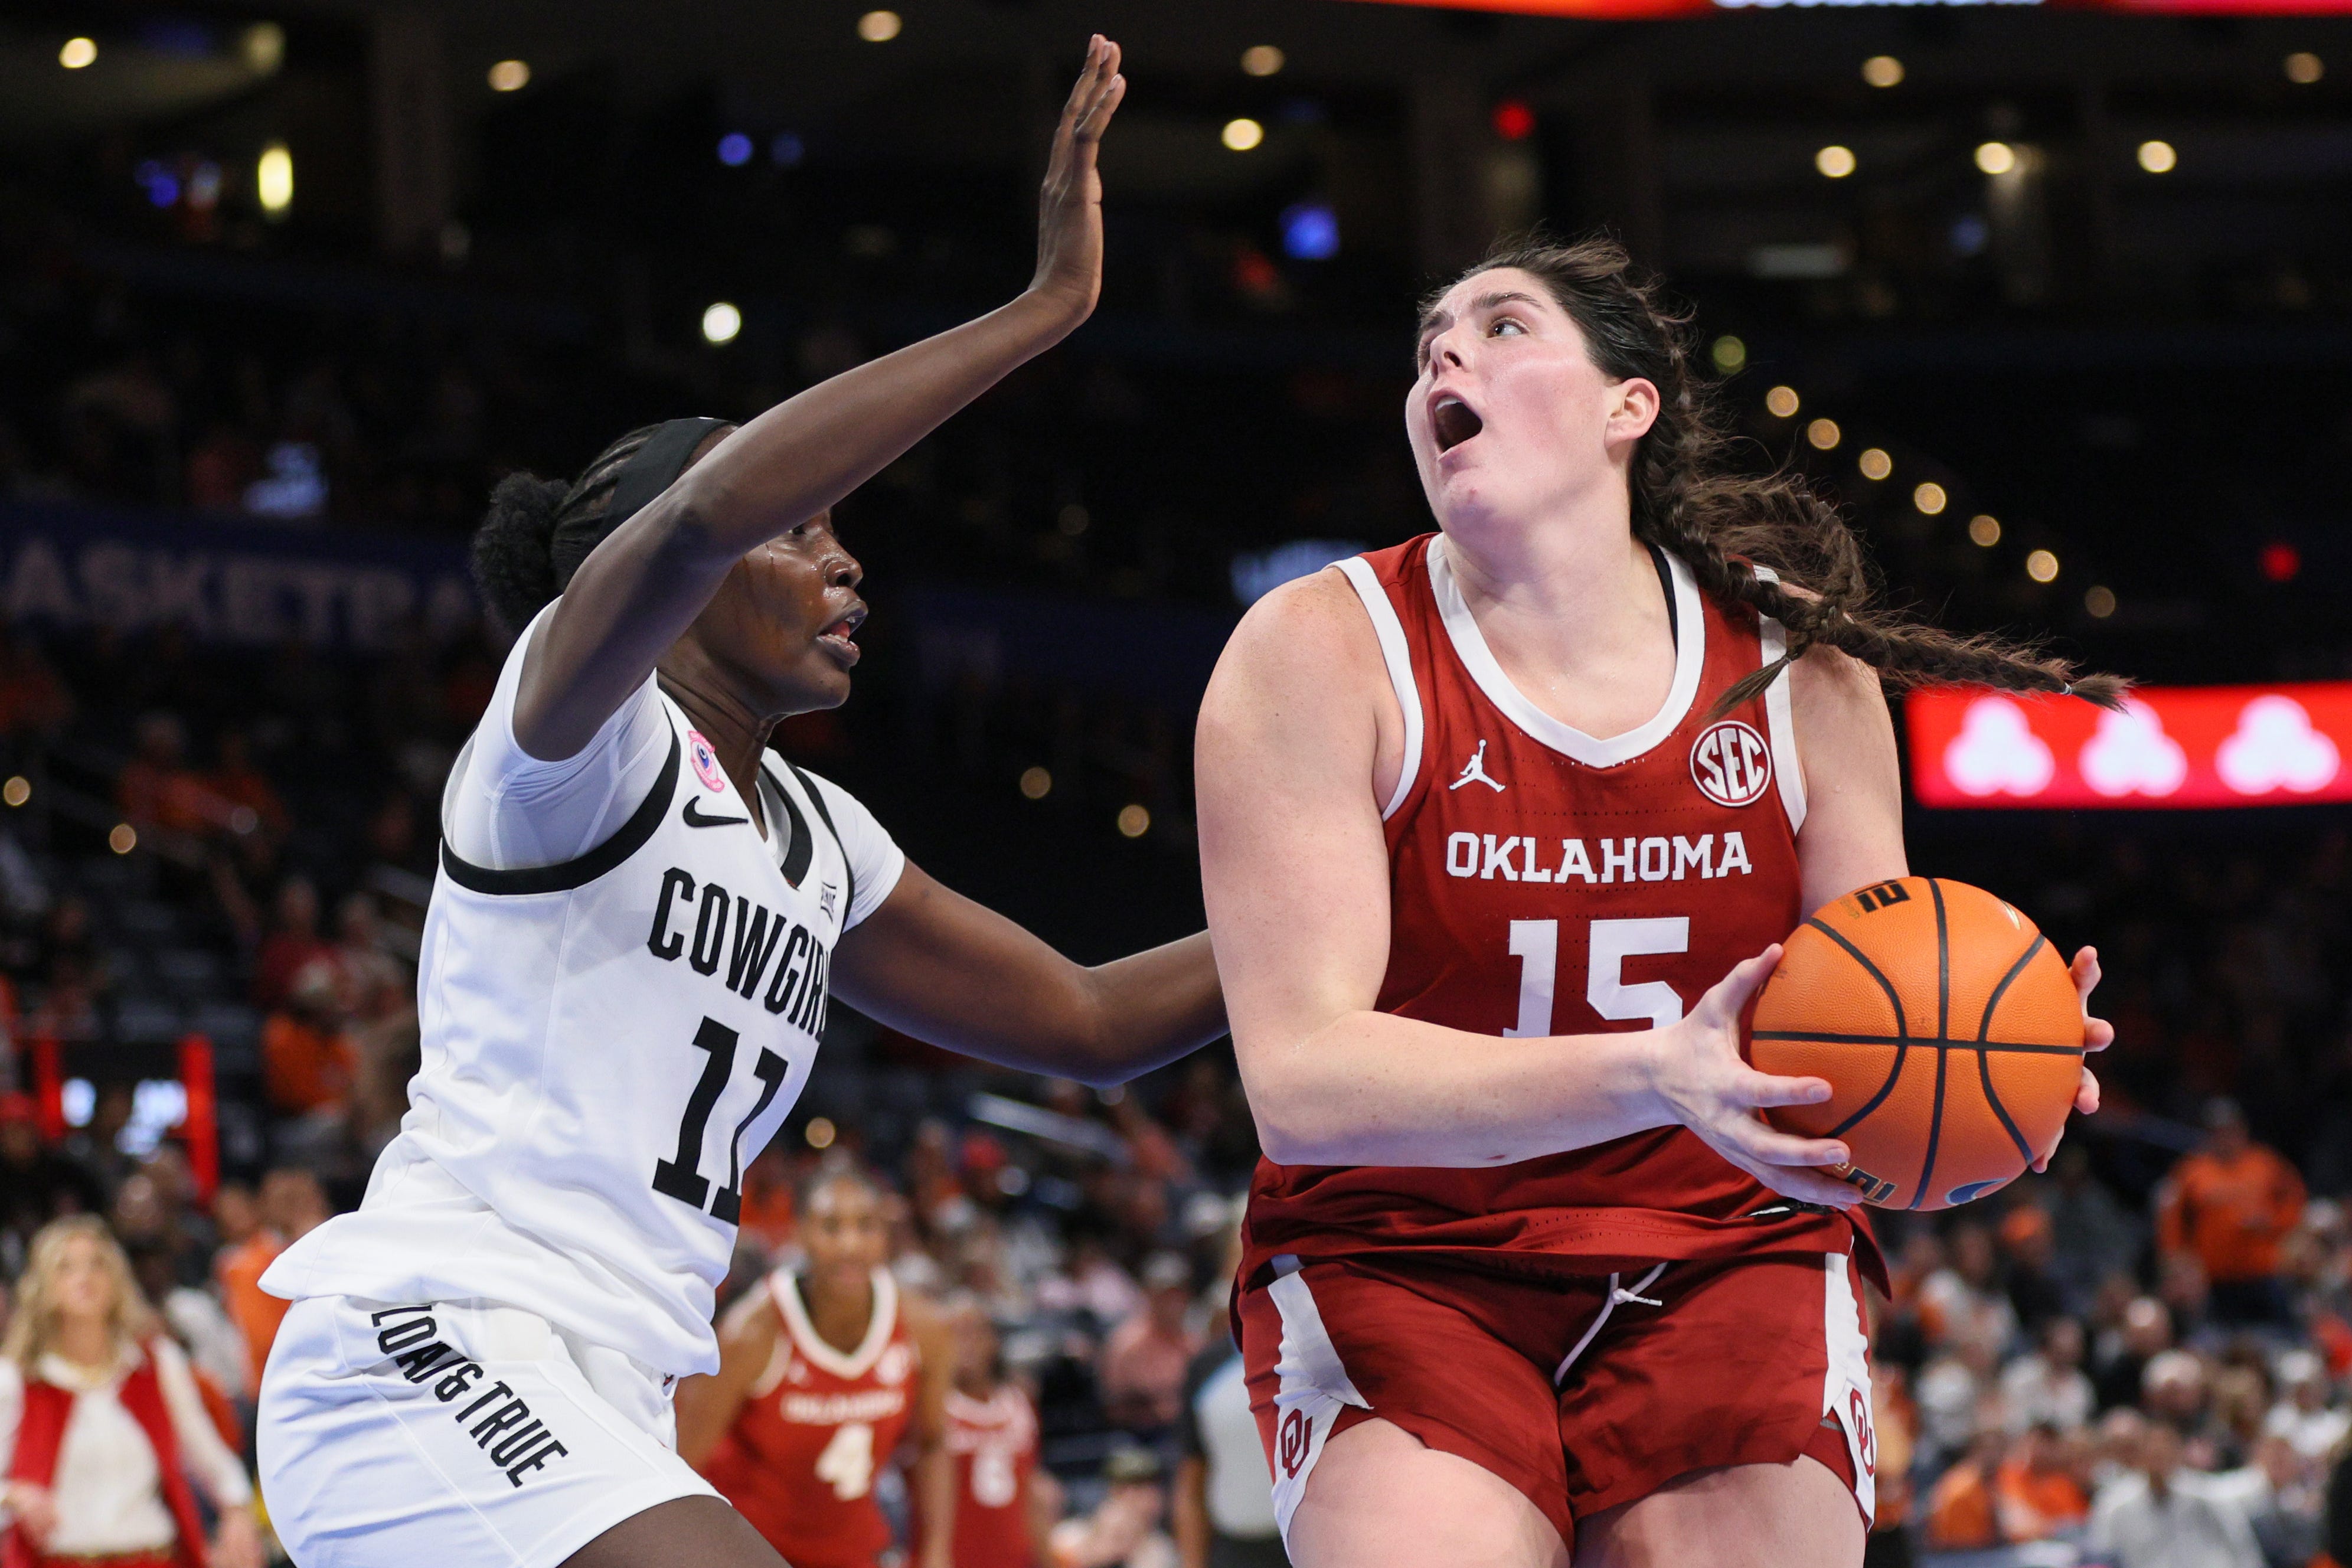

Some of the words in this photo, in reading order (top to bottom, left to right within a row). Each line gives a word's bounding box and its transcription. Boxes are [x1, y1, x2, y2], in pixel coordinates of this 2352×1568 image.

[1697, 728, 1765, 800] SEC
[1446, 831, 1752, 884] OKLAHOMA
[1502, 916, 1690, 1038] 15
[652, 1015, 789, 1227] 11
[455, 1380, 569, 1488] TRUE
[815, 1423, 875, 1501] 4
[1280, 1408, 1313, 1480] OU
